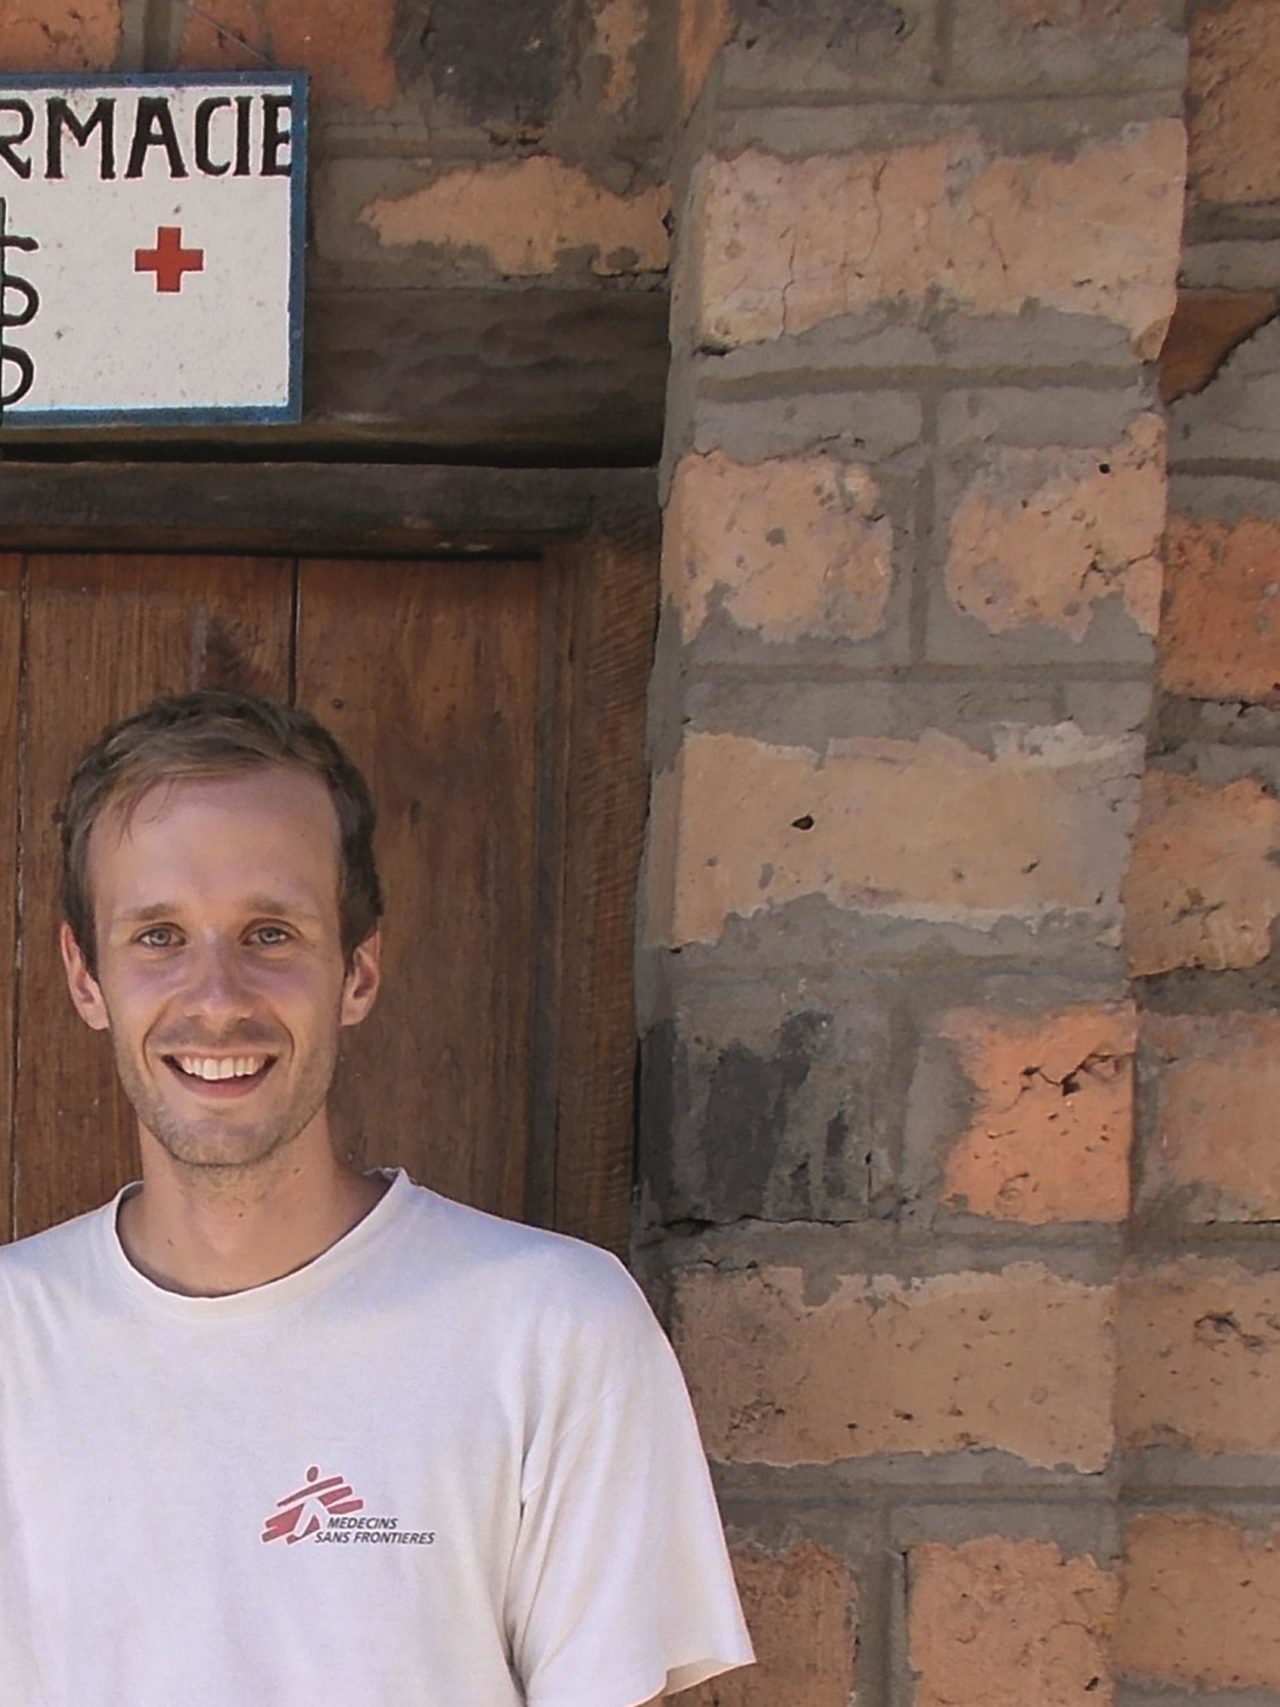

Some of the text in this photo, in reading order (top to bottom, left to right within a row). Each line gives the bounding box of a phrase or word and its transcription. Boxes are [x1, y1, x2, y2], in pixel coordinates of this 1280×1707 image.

[327, 1517, 398, 1529] MEDECINS
[315, 1531, 436, 1544] SANS FRONTIERES
